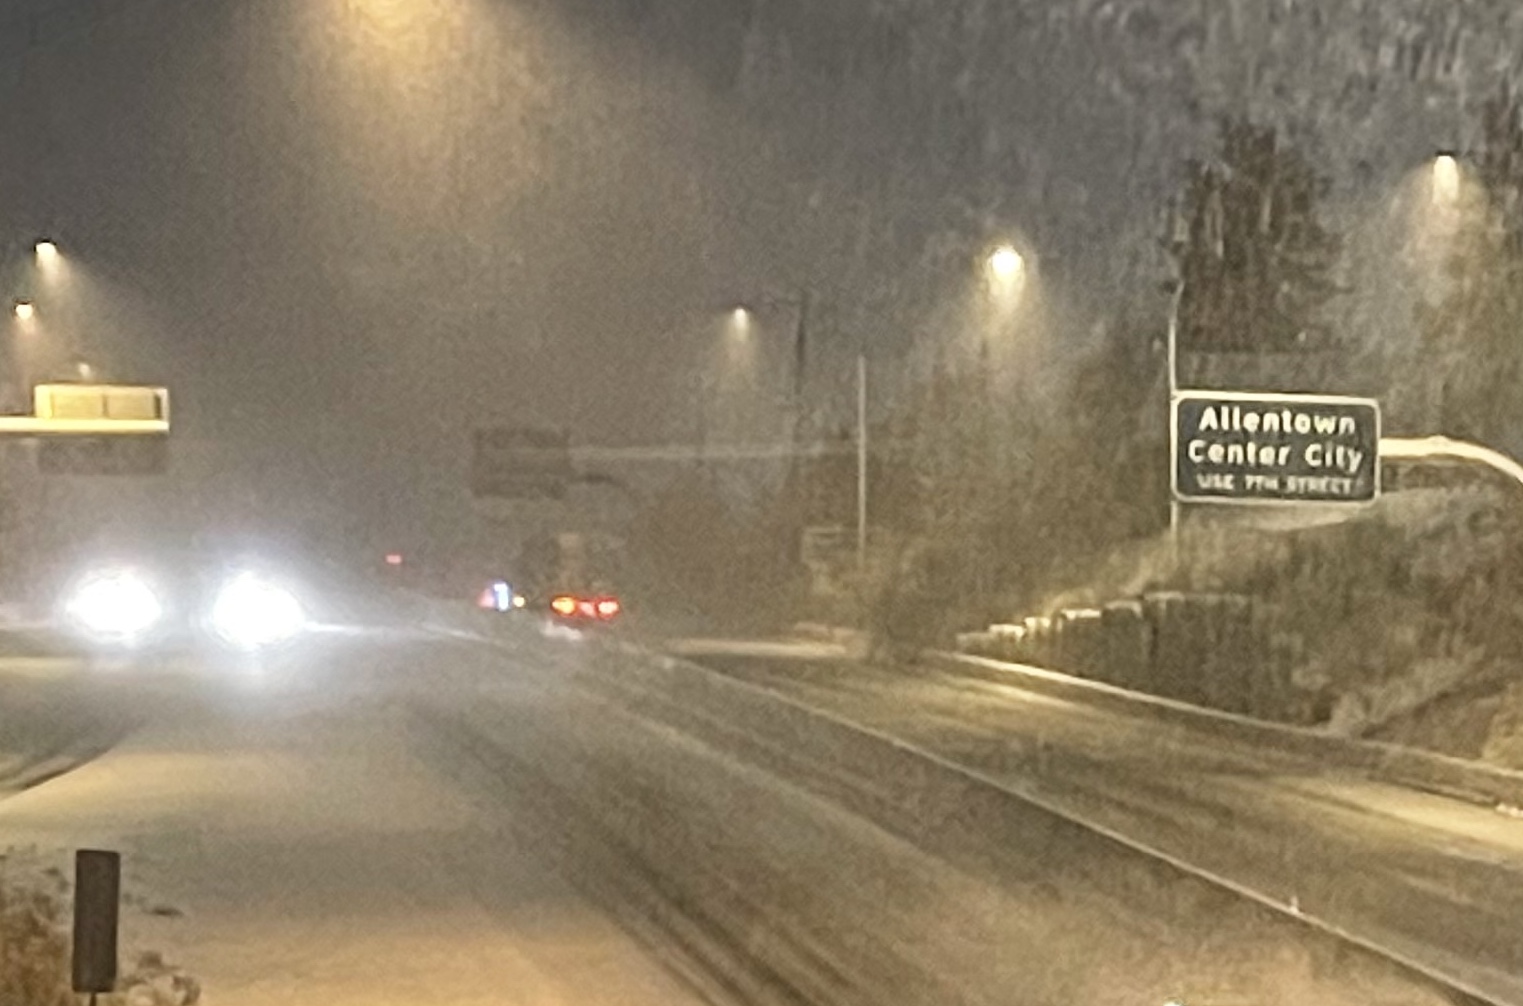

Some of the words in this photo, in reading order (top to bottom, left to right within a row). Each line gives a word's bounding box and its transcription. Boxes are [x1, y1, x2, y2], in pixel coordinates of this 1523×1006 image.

[1199, 405, 1356, 434] Allentown
[1188, 439, 1291, 467] Center
[1304, 443, 1363, 473] City
[1197, 473, 1235, 490] USE
[1245, 474, 1280, 491] 7TH
[1287, 475, 1353, 494] STREET
